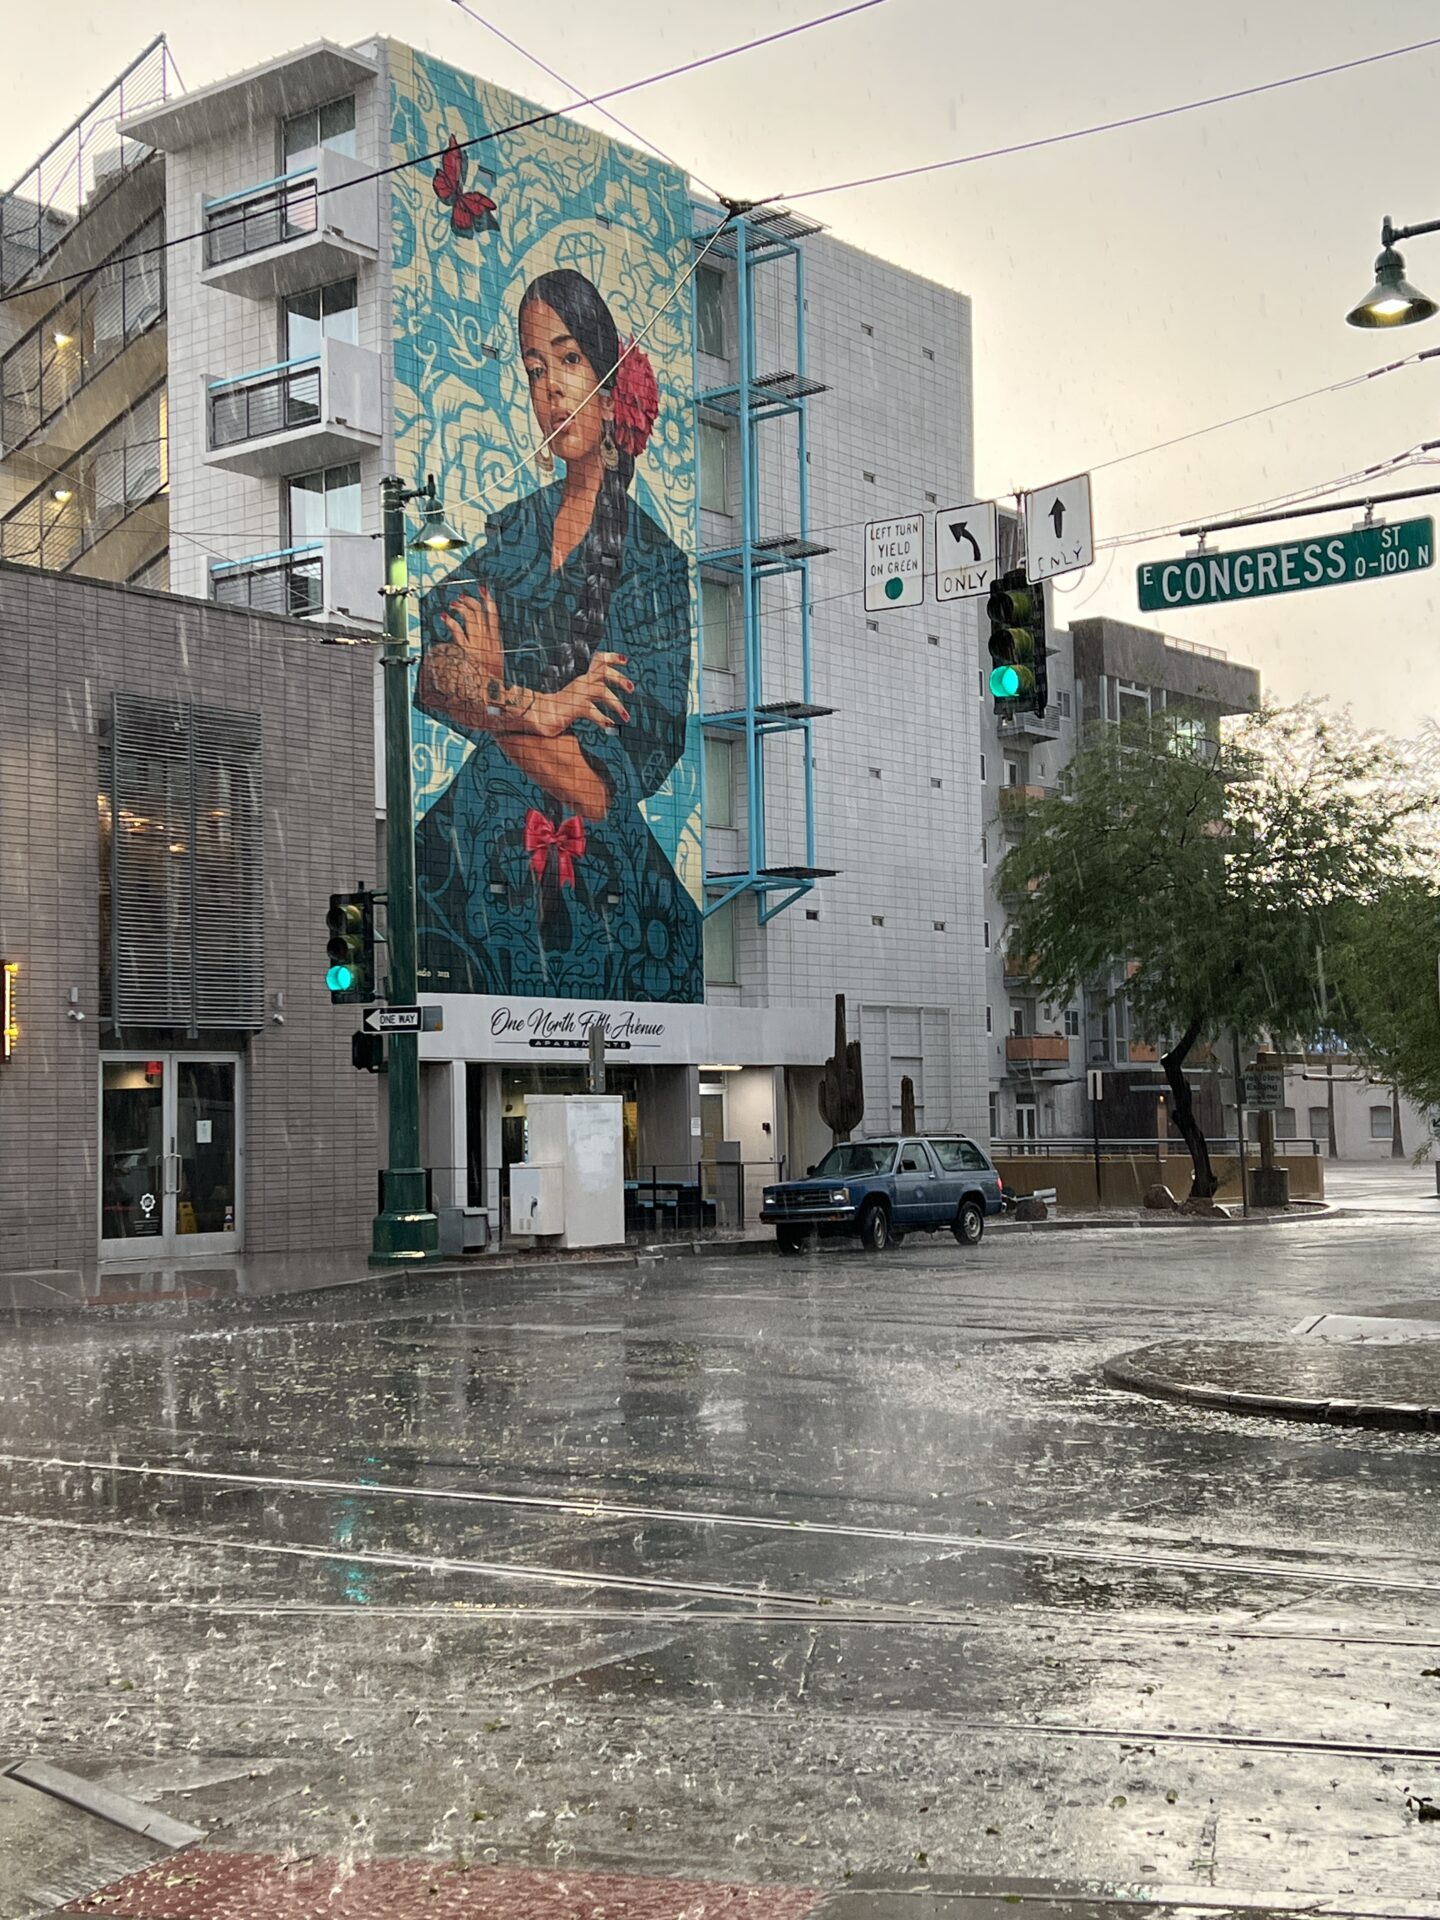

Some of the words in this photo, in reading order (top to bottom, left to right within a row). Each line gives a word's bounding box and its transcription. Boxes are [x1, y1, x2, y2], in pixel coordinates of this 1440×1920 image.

[870, 526, 892, 541] LEFT
[895, 522, 919, 536] TURN
[1381, 525, 1402, 548] ST
[878, 541, 911, 559] YIELD
[870, 563, 884, 577] ON
[887, 559, 919, 574] GREEN
[1143, 566, 1154, 586] E
[1162, 539, 1347, 603] CONGRESS
[1355, 549, 1410, 578] 0-100
[1417, 544, 1430, 567] N
[943, 569, 988, 593] ONLY
[379, 1014, 396, 1025] ONE
[398, 1013, 416, 1024] WAY
[490, 1006, 526, 1036] One
[527, 1007, 576, 1039] North
[611, 1011, 666, 1040] Avenue
[534, 1040, 627, 1049] APARTMNTS
